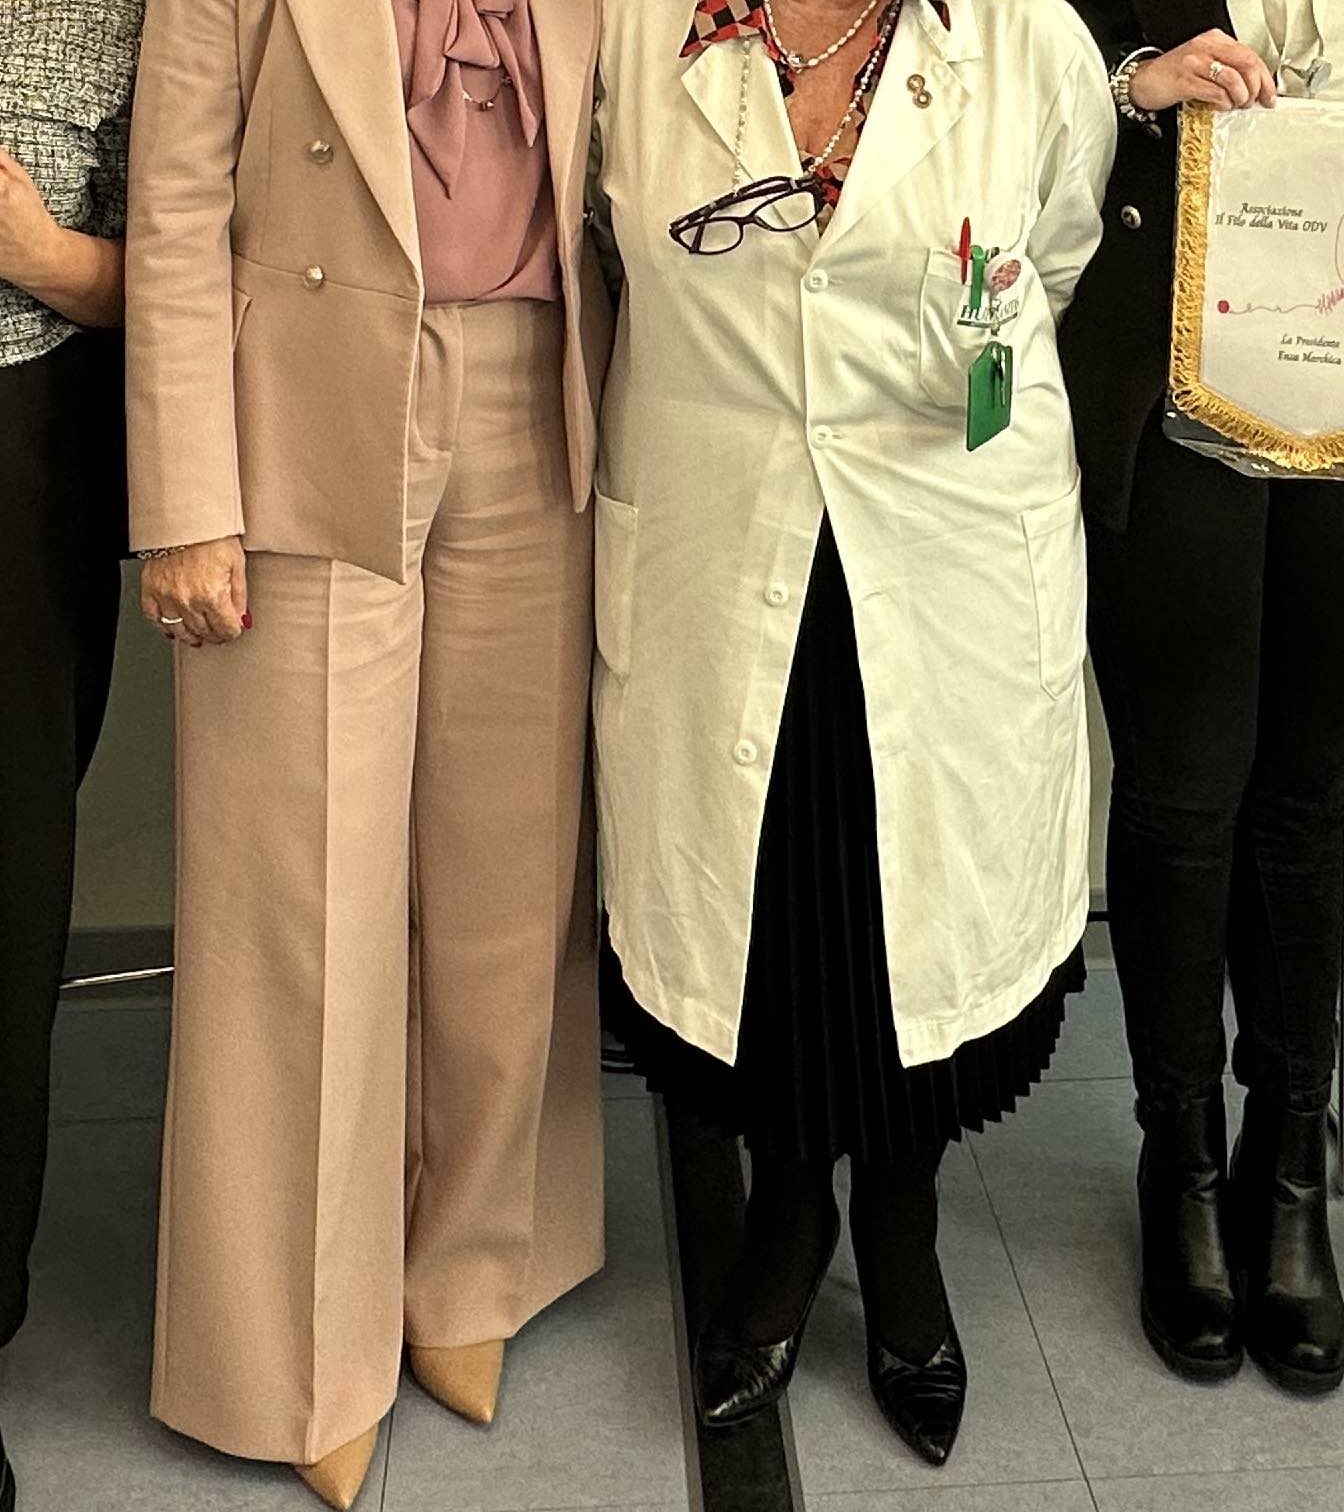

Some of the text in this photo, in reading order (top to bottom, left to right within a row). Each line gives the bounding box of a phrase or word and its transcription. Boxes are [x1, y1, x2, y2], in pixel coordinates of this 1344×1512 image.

[1215, 212, 1328, 233] Il Filo della Vita ODV
